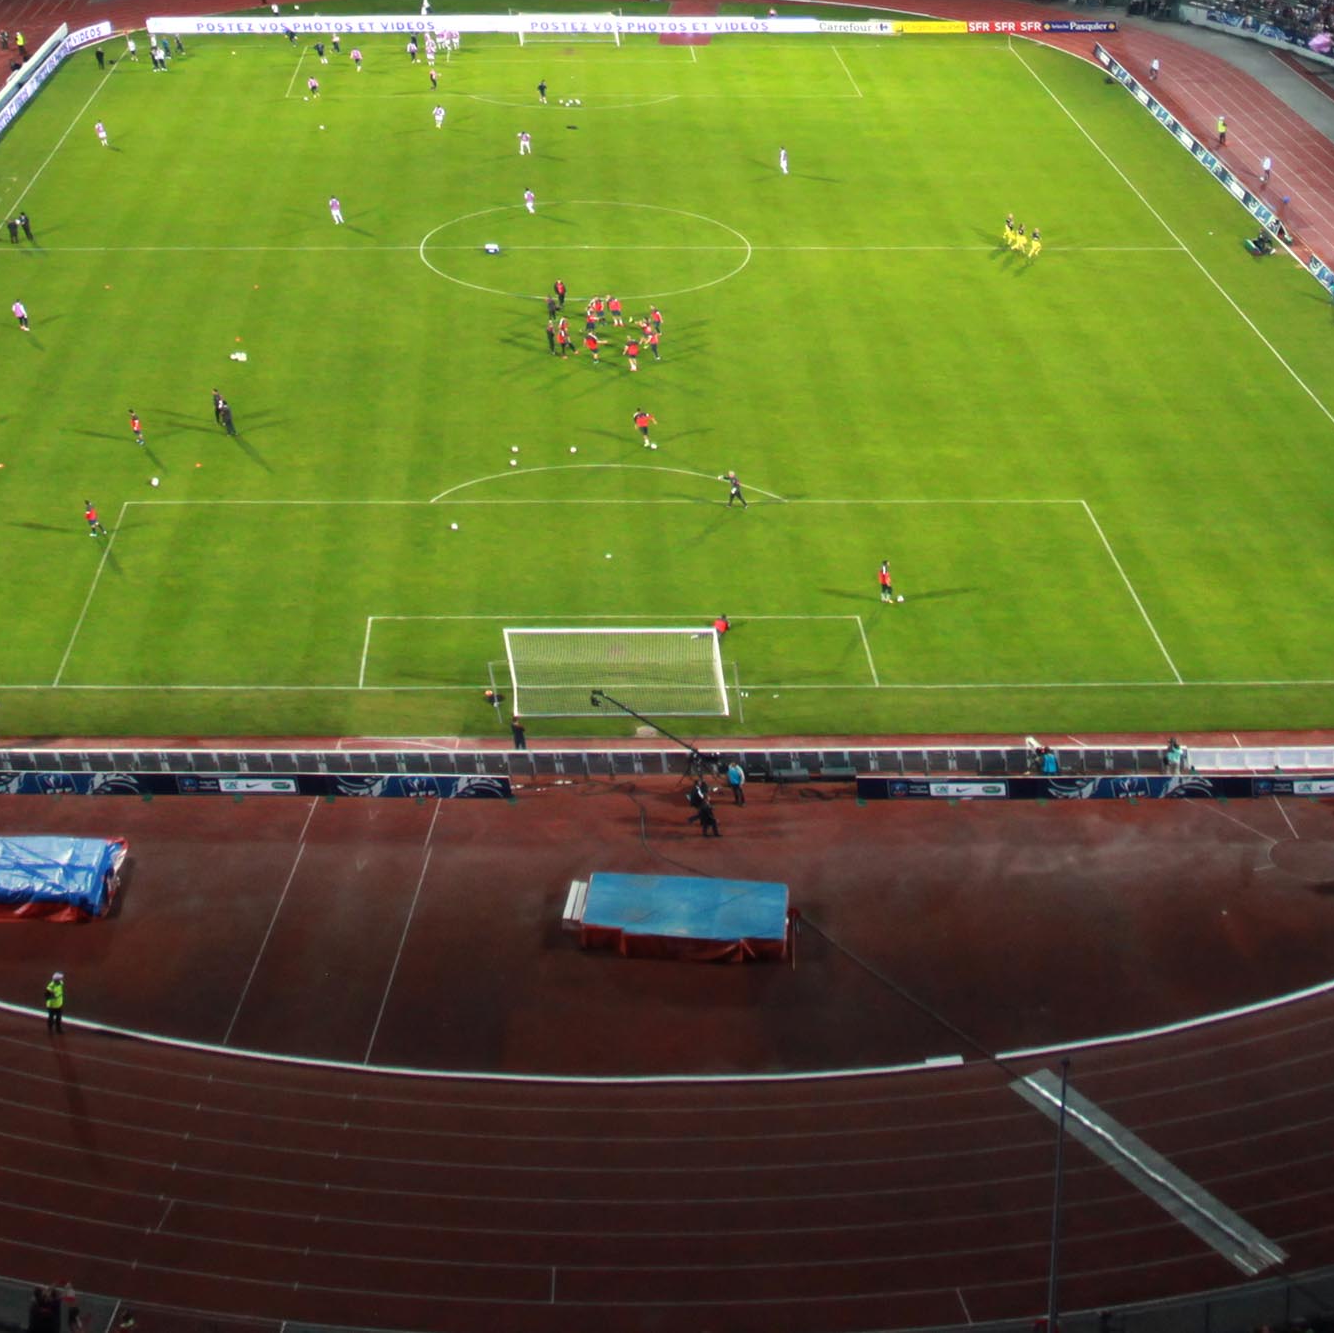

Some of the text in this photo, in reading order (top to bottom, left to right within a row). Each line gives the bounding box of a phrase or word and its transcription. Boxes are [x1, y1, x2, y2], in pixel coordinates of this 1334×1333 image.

[197, 21, 435, 32] POSTEZ VOS PHOTOS ET VIDEOS
[531, 21, 769, 32] POSTEZ VOS PHOTOS ET VIDEOS
[819, 22, 872, 32] Carrefour
[969, 21, 990, 32] SFR
[995, 21, 1015, 32] SFR
[1020, 21, 1042, 32] SFR
[1070, 22, 1107, 31] Pasquier
[72, 27, 101, 44] VIDEOS
